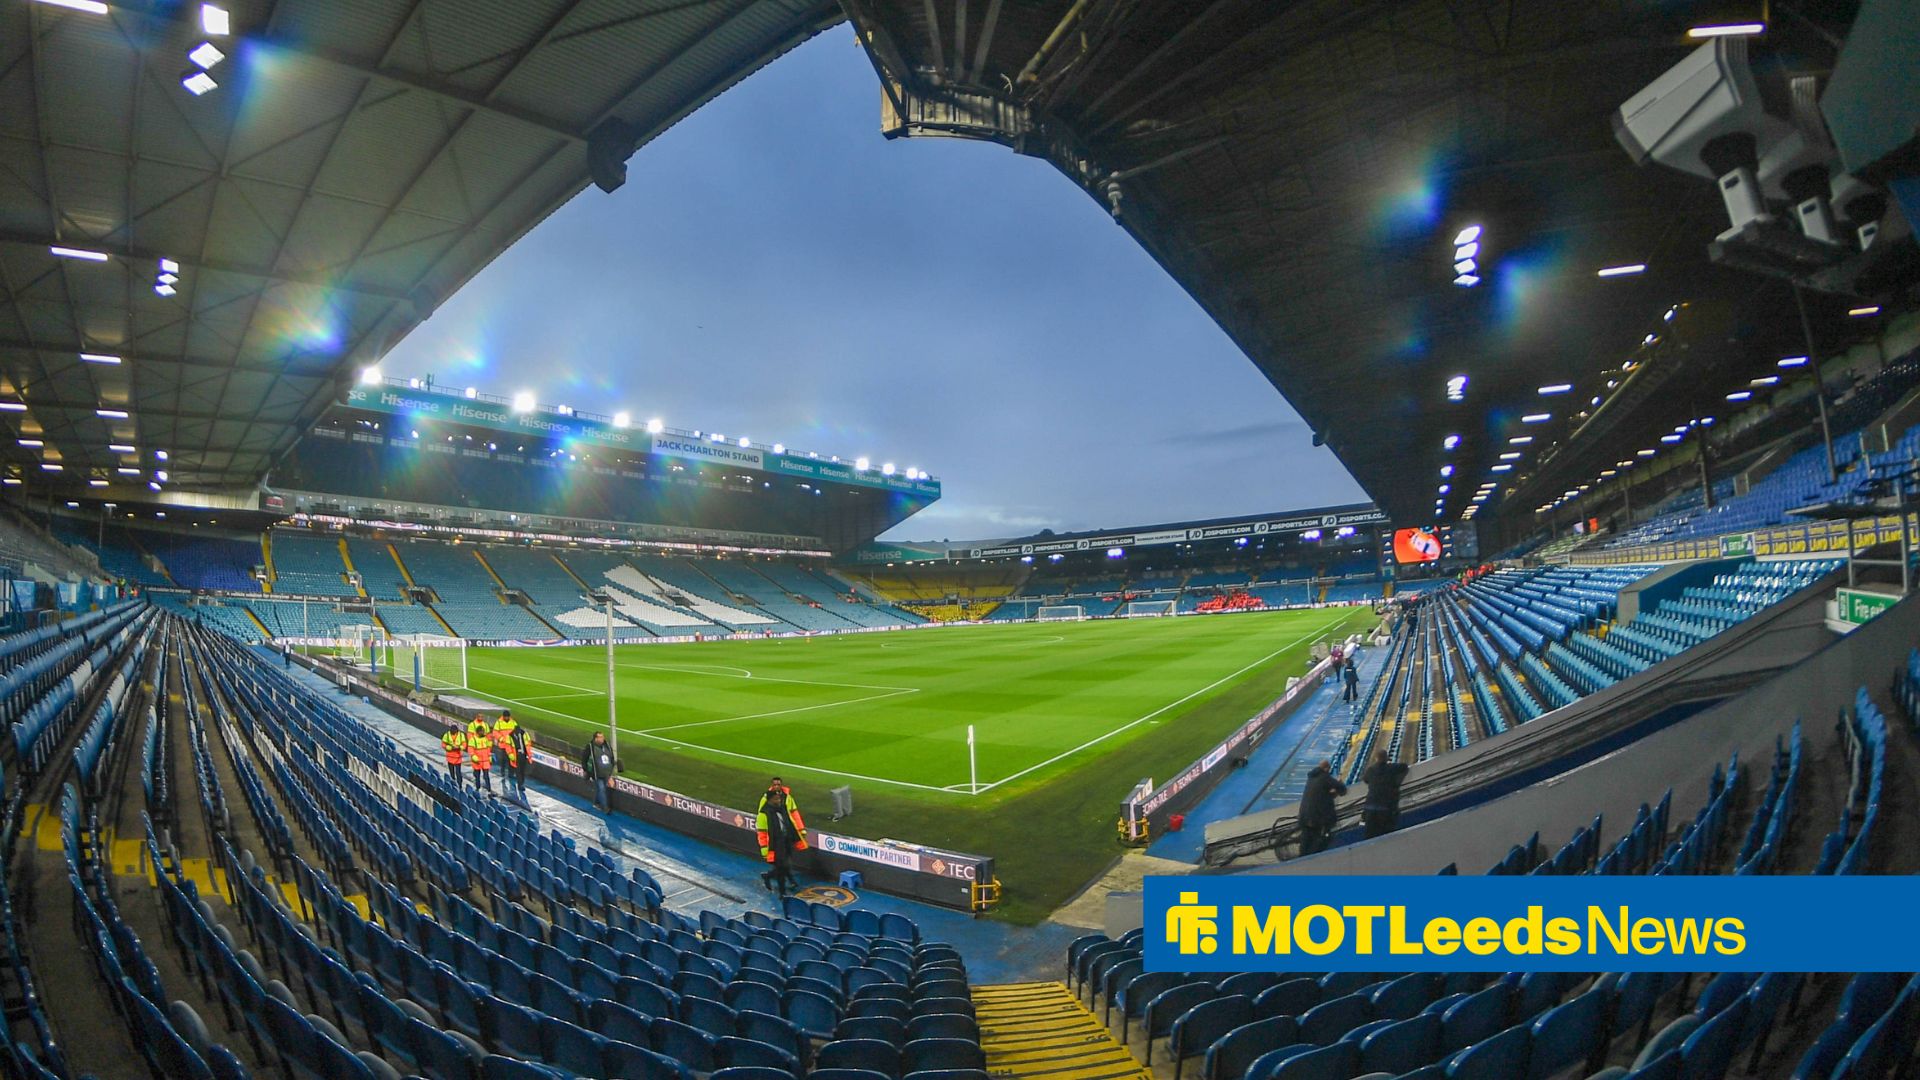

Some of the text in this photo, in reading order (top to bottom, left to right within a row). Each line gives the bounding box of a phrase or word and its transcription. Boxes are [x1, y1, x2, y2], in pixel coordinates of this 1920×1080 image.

[381, 392, 439, 412] Hisense
[452, 404, 507, 423] Hisense
[519, 416, 570, 433] Hisense
[581, 426, 629, 442] Hisense
[656, 439, 759, 463] JACK CHARLTON STAND
[781, 459, 813, 473] Hisense
[820, 466, 849, 479] Hisense
[855, 472, 882, 484] Hisense
[1204, 526, 1251, 537] JDSPORTS.COM
[1270, 519, 1318, 530] JDSPORTS.COM
[857, 549, 902, 562] Hisense
[615, 779, 655, 800] TECHNI-TILE
[672, 797, 721, 821] TECHNI-TILE
[838, 841, 912, 867] COMMUNITY PARTNER
[947, 862, 975, 881] TEC
